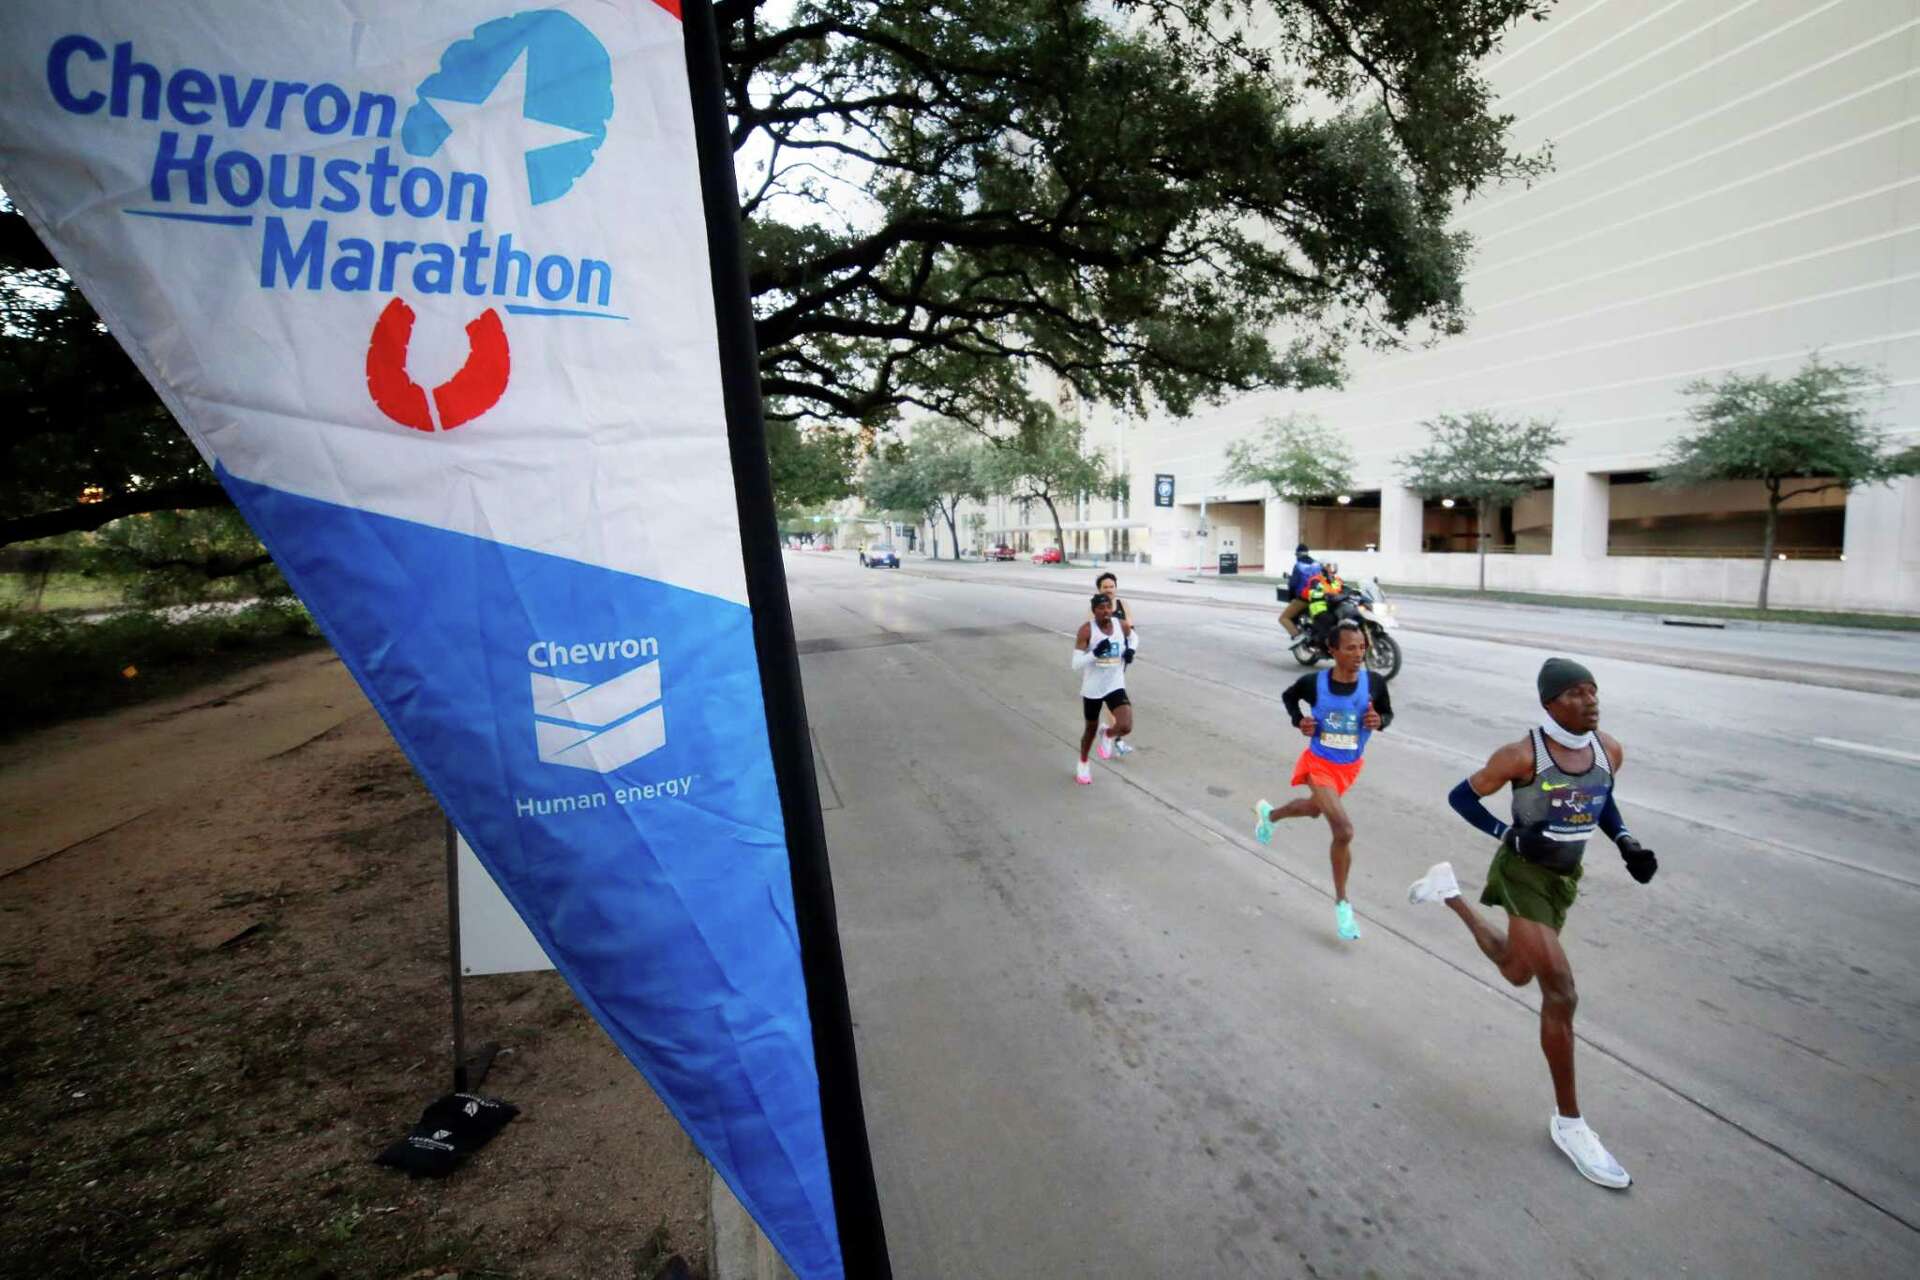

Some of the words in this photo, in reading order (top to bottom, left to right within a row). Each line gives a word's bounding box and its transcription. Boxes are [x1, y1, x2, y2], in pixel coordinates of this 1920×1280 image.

[46, 34, 397, 138] Chevron
[150, 131, 488, 222] Houston
[259, 216, 612, 306] Marathon
[527, 636, 659, 668] Chevron
[516, 792, 606, 818] Human
[614, 775, 693, 804] energy
